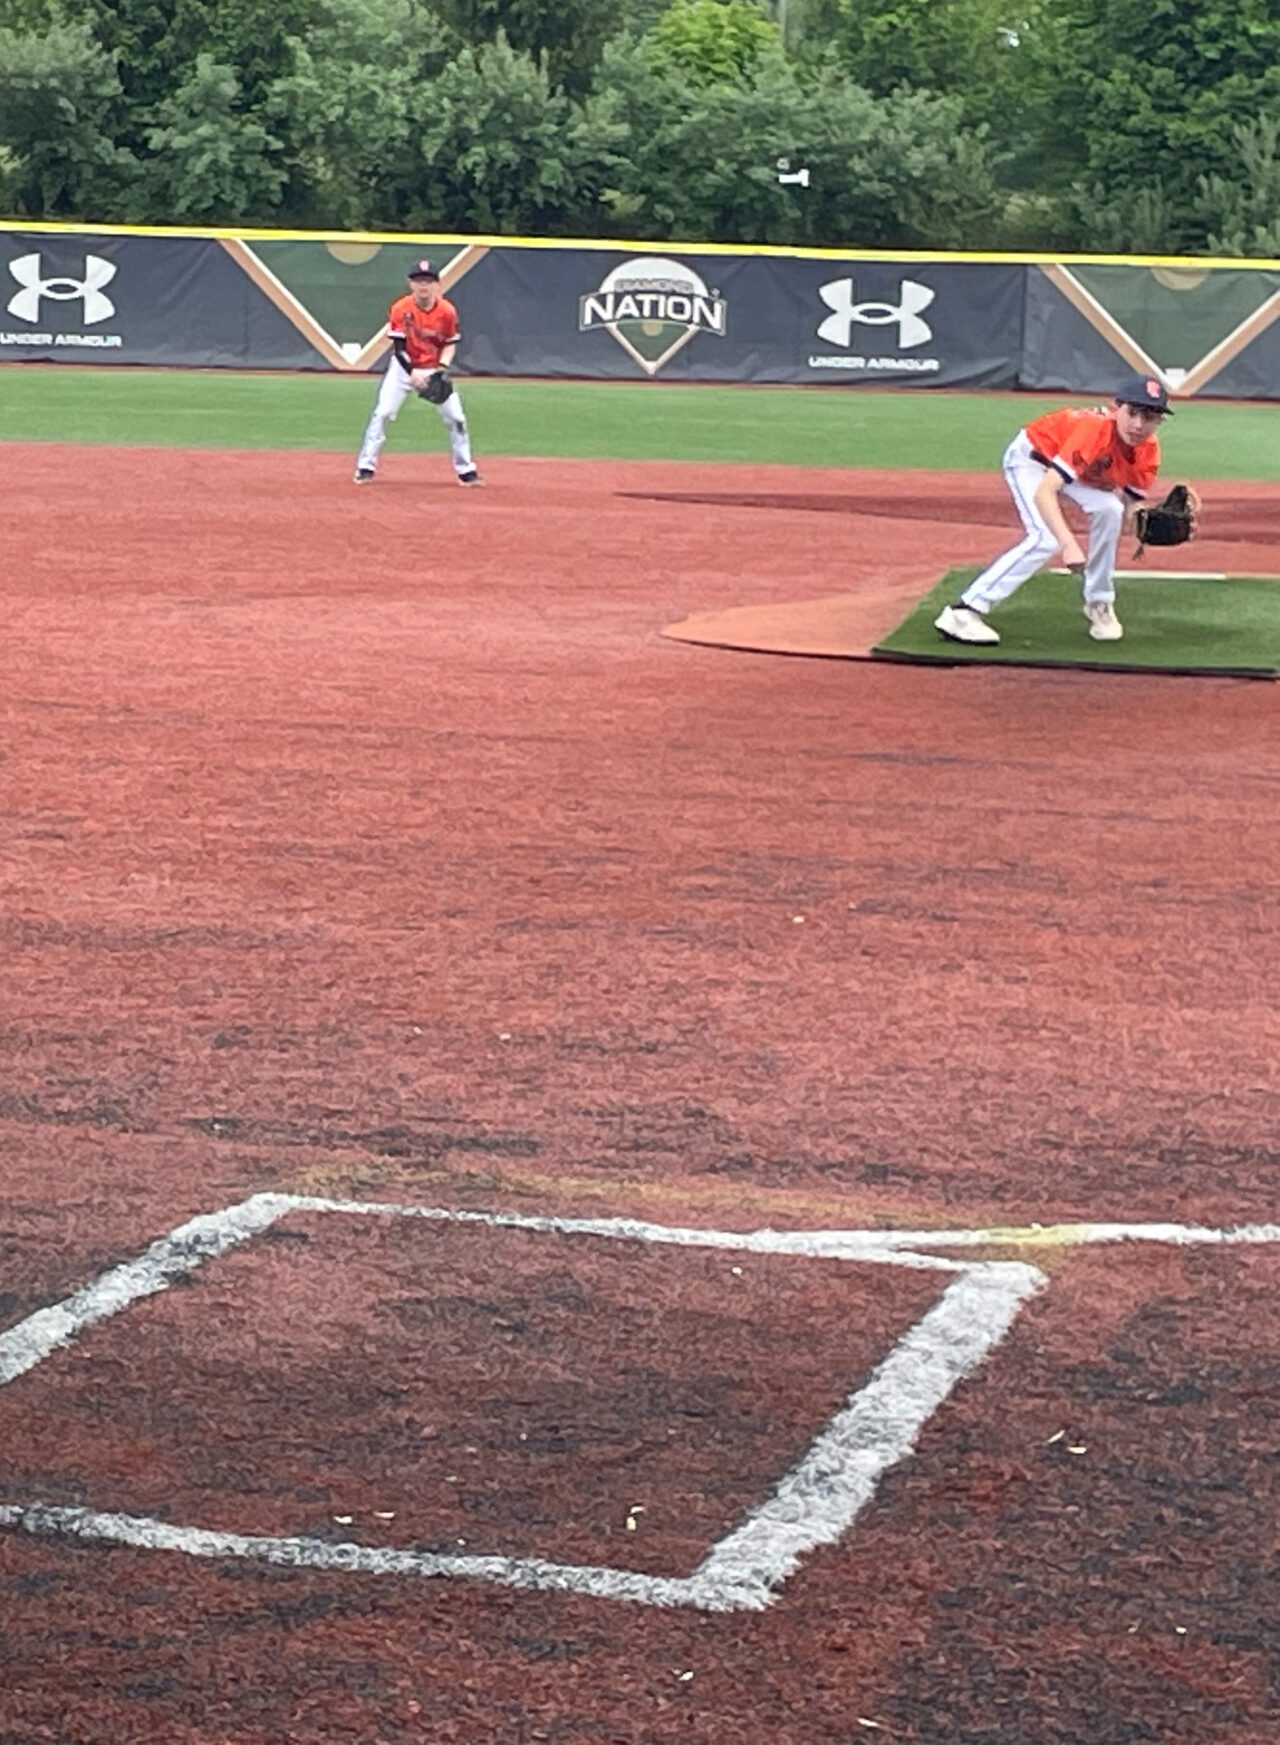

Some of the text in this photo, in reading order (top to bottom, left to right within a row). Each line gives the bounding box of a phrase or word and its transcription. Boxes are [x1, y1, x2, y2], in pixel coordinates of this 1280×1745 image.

[583, 292, 723, 330] NATION
[0, 331, 122, 348] UNDER ARMOUR
[808, 355, 939, 372] UNDER ARMOUR
